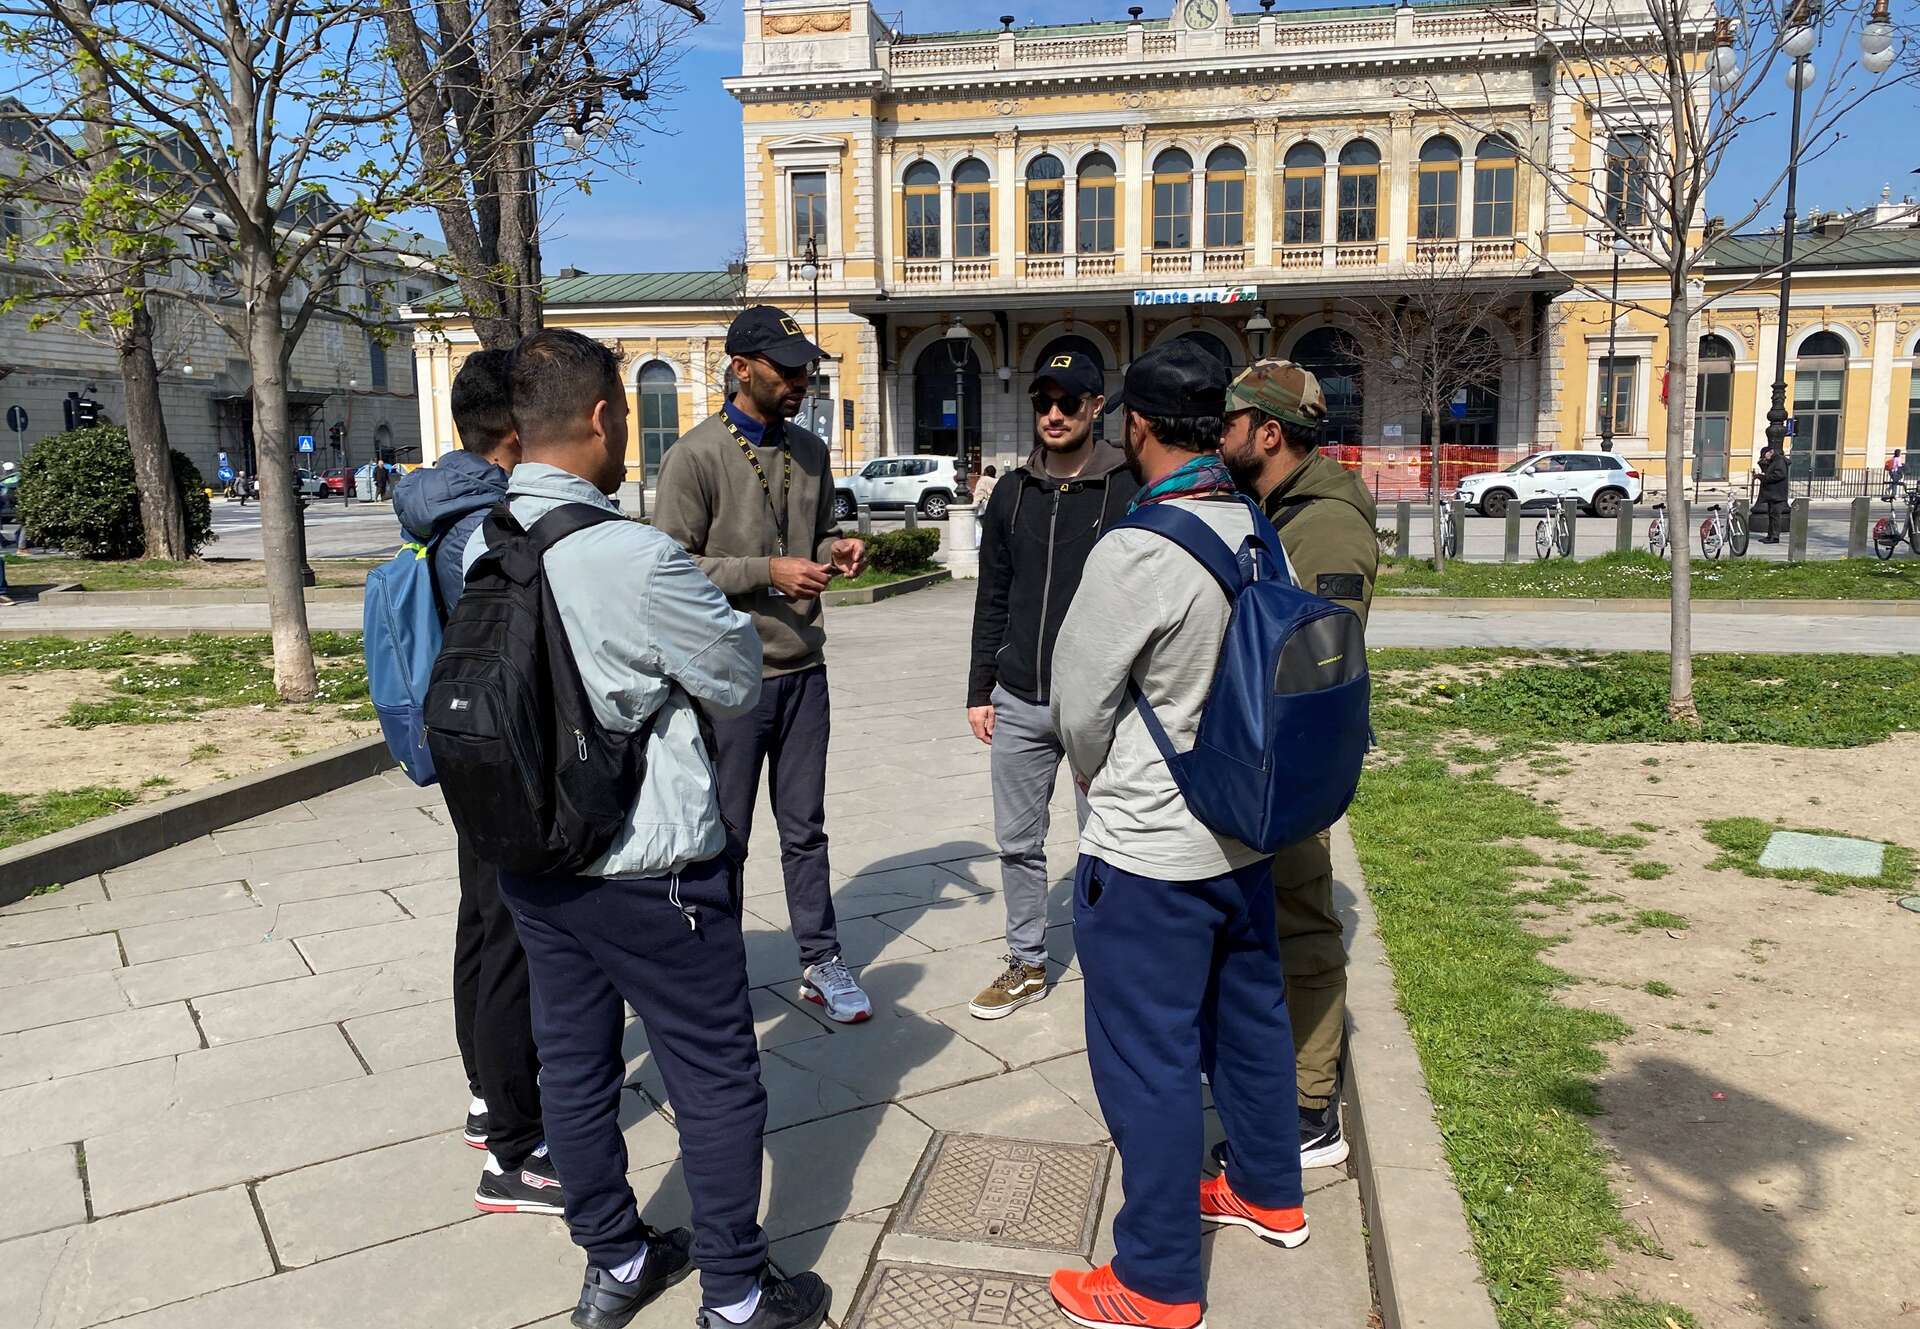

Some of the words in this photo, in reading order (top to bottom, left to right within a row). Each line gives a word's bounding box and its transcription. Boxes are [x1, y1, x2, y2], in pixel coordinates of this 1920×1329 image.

[1135, 290, 1189, 305] Trieste
[979, 1166, 1011, 1214] VERDE
[1004, 1163, 1037, 1220] PUBBLICO
